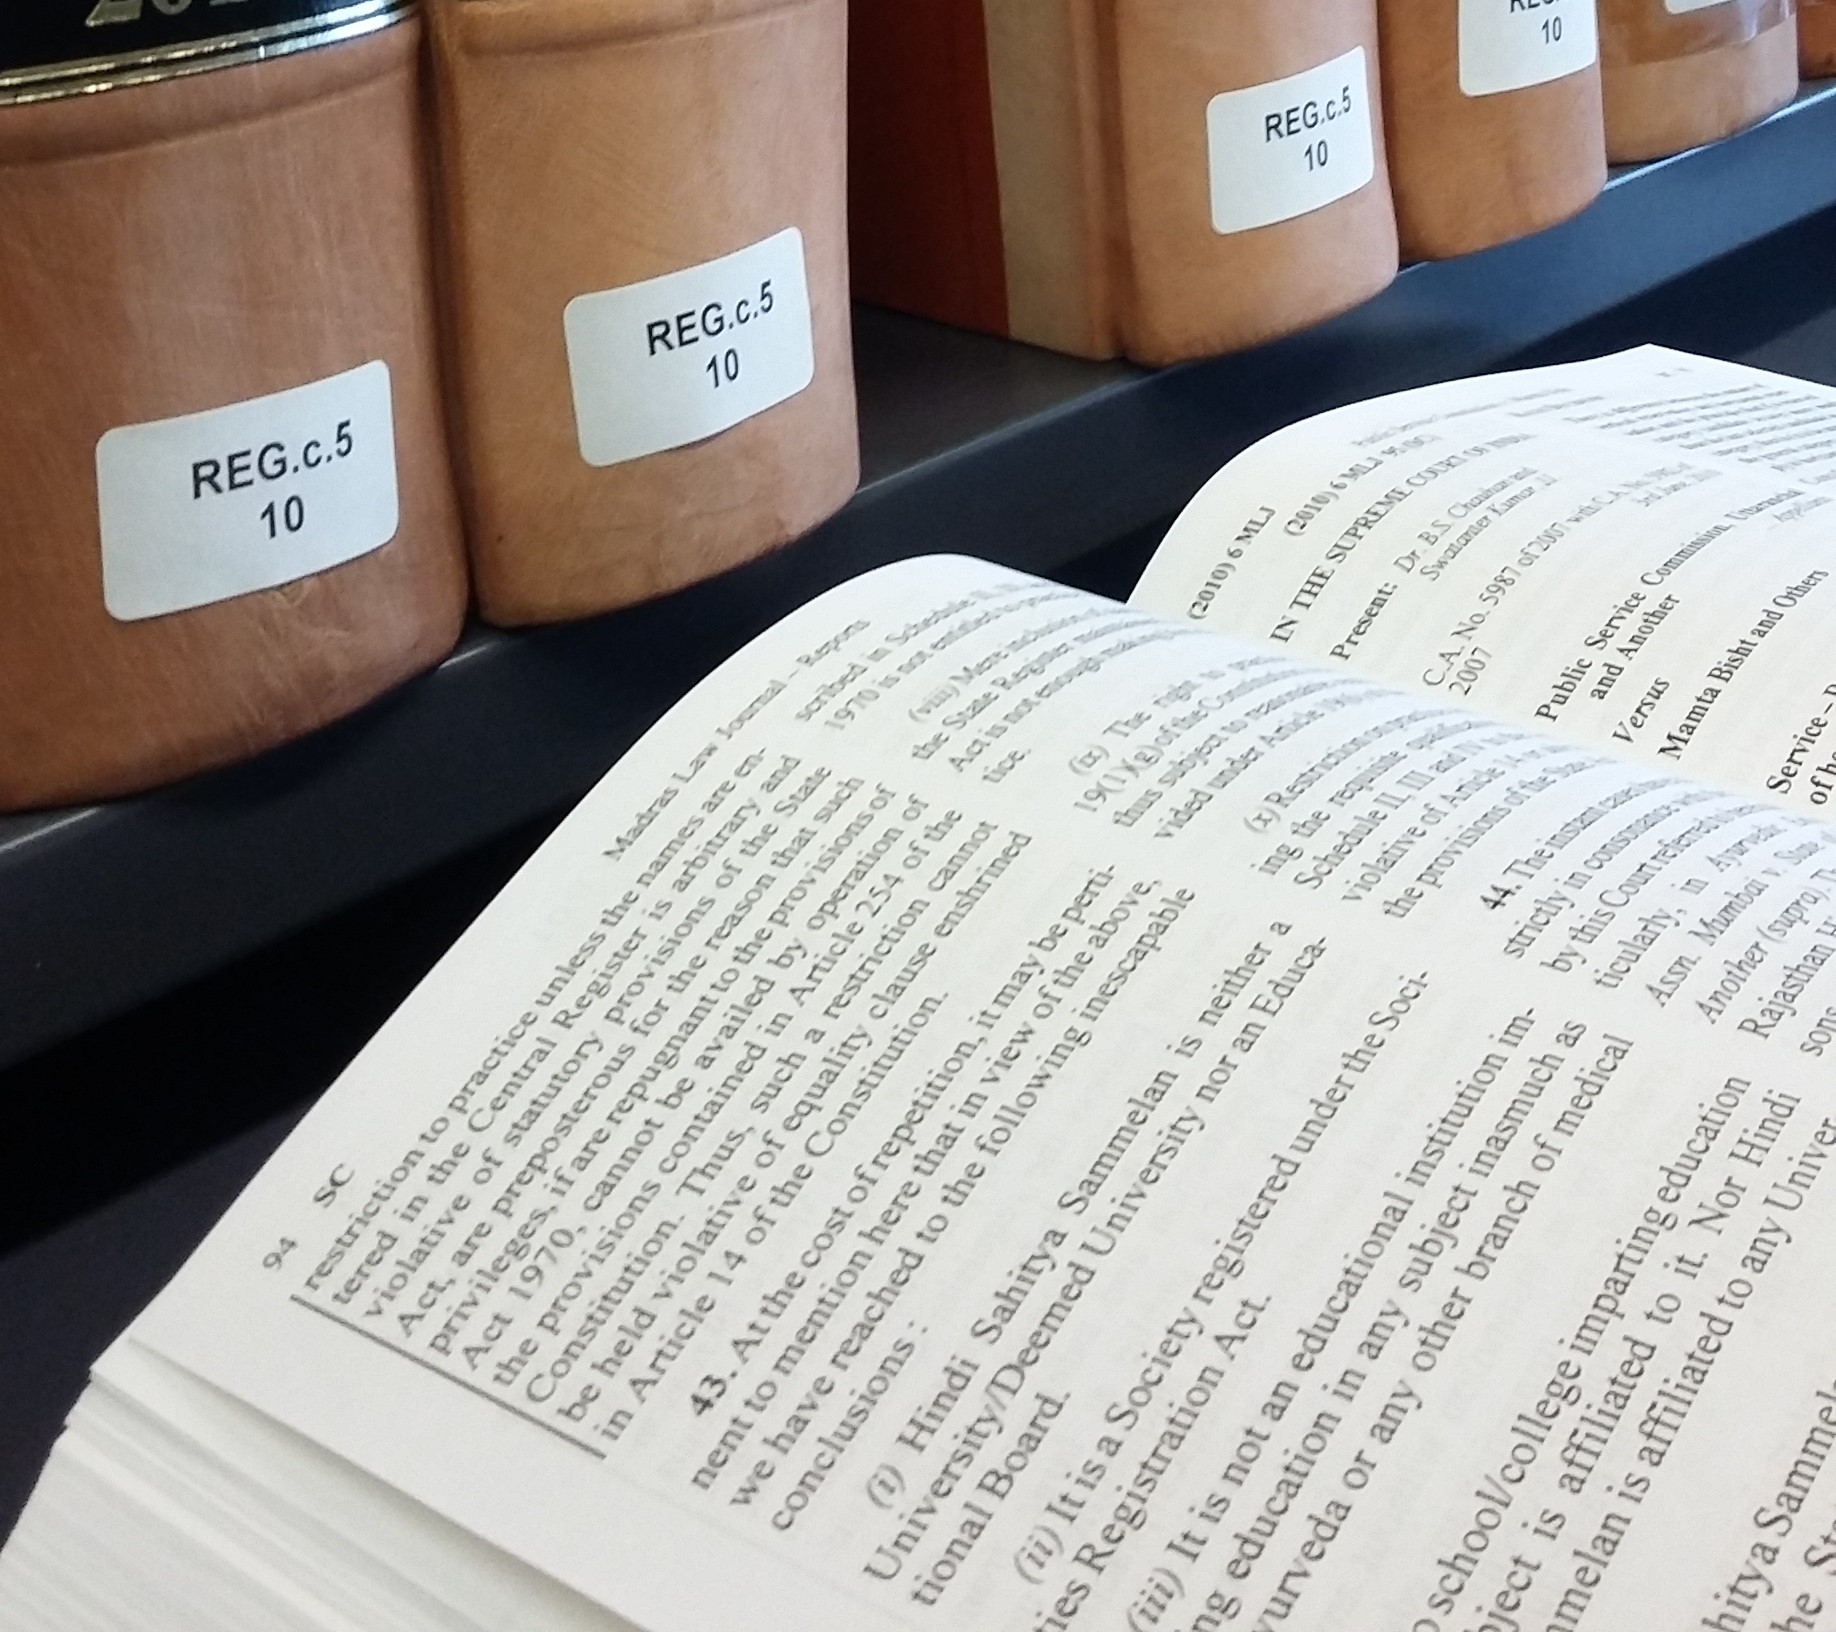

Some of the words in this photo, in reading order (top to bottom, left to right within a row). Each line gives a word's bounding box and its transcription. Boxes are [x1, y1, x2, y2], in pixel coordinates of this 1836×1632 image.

[1540, 16, 1564, 45] 10
[1264, 85, 1353, 143] REG.c.5
[1303, 139, 1329, 173] 10
[645, 278, 776, 357] REG.c.5
[704, 348, 741, 390] 10
[190, 419, 354, 500] REG.c.5
[1338, 456, 1384, 482] MLJ
[259, 494, 305, 541] 10
[1226, 547, 1244, 559] 6
[1233, 505, 1276, 545] MLJ
[1269, 614, 1299, 643] IN
[1289, 565, 1336, 610] THE
[1324, 487, 1414, 565] SUPREME
[1405, 454, 1468, 488] COURT
[1188, 562, 1236, 620] (2010)
[1328, 582, 1398, 661] Present:
[1422, 645, 1466, 687] C.A.
[1452, 610, 1491, 642] No.
[1478, 565, 1521, 607] 5987
[1516, 546, 1541, 568] of
[1447, 645, 1492, 697] 2007
[1533, 658, 1593, 723] Public
[1583, 591, 1647, 651] Service
[1589, 661, 1625, 700] and
[1615, 593, 1680, 662] Another
[1656, 687, 1722, 761] Mamta
[1706, 638, 1759, 684] Bisht
[1750, 608, 1785, 639] and
[1771, 569, 1830, 608] Others
[1067, 744, 1111, 776] (ix)
[1101, 711, 1153, 739] The
[1611, 676, 1670, 744] Versus
[602, 786, 680, 862] Madras
[672, 742, 719, 784] Law
[714, 679, 788, 741] Journal
[1112, 788, 1164, 828] thus
[1157, 733, 1230, 788] subject
[1153, 787, 1215, 838] vided
[1206, 745, 1265, 790] under
[1765, 716, 1829, 795] Service
[1809, 774, 1834, 805] of
[1292, 809, 1389, 890] Schedule
[1340, 826, 1428, 901] violative
[1419, 801, 1450, 826] of
[1382, 886, 1425, 919] the
[1414, 804, 1513, 889] provisions
[1479, 884, 1523, 910] 44.
[1501, 848, 1555, 880] The
[1502, 889, 1576, 959] strictly
[1553, 870, 1594, 891] in
[1593, 907, 1687, 989] ticularly,
[1669, 877, 1710, 896] in
[1644, 954, 1702, 1009] Assn.
[1686, 878, 1770, 948] Mumbai
[303, 1148, 426, 1292] restriction
[418, 1115, 450, 1144] to
[447, 1010, 539, 1115] practice
[534, 930, 607, 1007] unless
[599, 889, 641, 928] the
[635, 815, 705, 889] names
[700, 779, 737, 814] are
[733, 746, 767, 779] en-
[1247, 936, 1327, 1018] Educa-
[1694, 940, 1769, 1026] Another
[1736, 943, 1836, 1040] Rajasthan
[1194, 1053, 1239, 1104] nor
[1231, 1021, 1267, 1054] an
[492, 1337, 540, 1387] the
[535, 1179, 662, 1337] provisions
[657, 1039, 769, 1174] contained
[756, 1012, 795, 1038] in
[787, 920, 865, 1008] Article
[854, 873, 905, 919] 254
[901, 838, 931, 870] of
[922, 809, 964, 842] the
[1727, 1088, 1802, 1168] Hindi
[261, 1236, 298, 1270] 94
[312, 1163, 354, 1209] SC
[865, 1463, 907, 1510] (i)
[894, 1353, 981, 1454] Hindi
[970, 1228, 1069, 1346] Sahitya
[1056, 1069, 1180, 1216] Sammelan
[1165, 1034, 1203, 1059] is
[1197, 940, 1273, 1028] neither
[1269, 921, 1293, 936] a
[1078, 1104, 1206, 1257] University
[1687, 1175, 1748, 1236] Nor
[1662, 1252, 1709, 1280] it.
[1126, 1567, 1185, 1632] (iii)
[1164, 1529, 1209, 1564] It
[1187, 1492, 1231, 1525] is
[1220, 1426, 1272, 1488] not
[1260, 1380, 1300, 1422] an
[1291, 1190, 1415, 1373] educational
[1394, 1052, 1509, 1188] institution
[1488, 1007, 1536, 1049] im-
[1427, 1359, 1583, 1617] school/college
[1557, 1205, 1679, 1357] imparting
[1656, 1076, 1752, 1204] education
[1643, 1292, 1682, 1325] to
[771, 1337, 915, 1532] conclusions
[862, 1259, 1097, 1581] University/Deemed
[1071, 1365, 1225, 1576] Registration
[1212, 1295, 1272, 1362] Act.
[1558, 1334, 1658, 1495] affiliated
[910, 1500, 995, 1607] tional
[974, 1391, 1071, 1501] Board.
[1520, 1508, 1567, 1542] is
